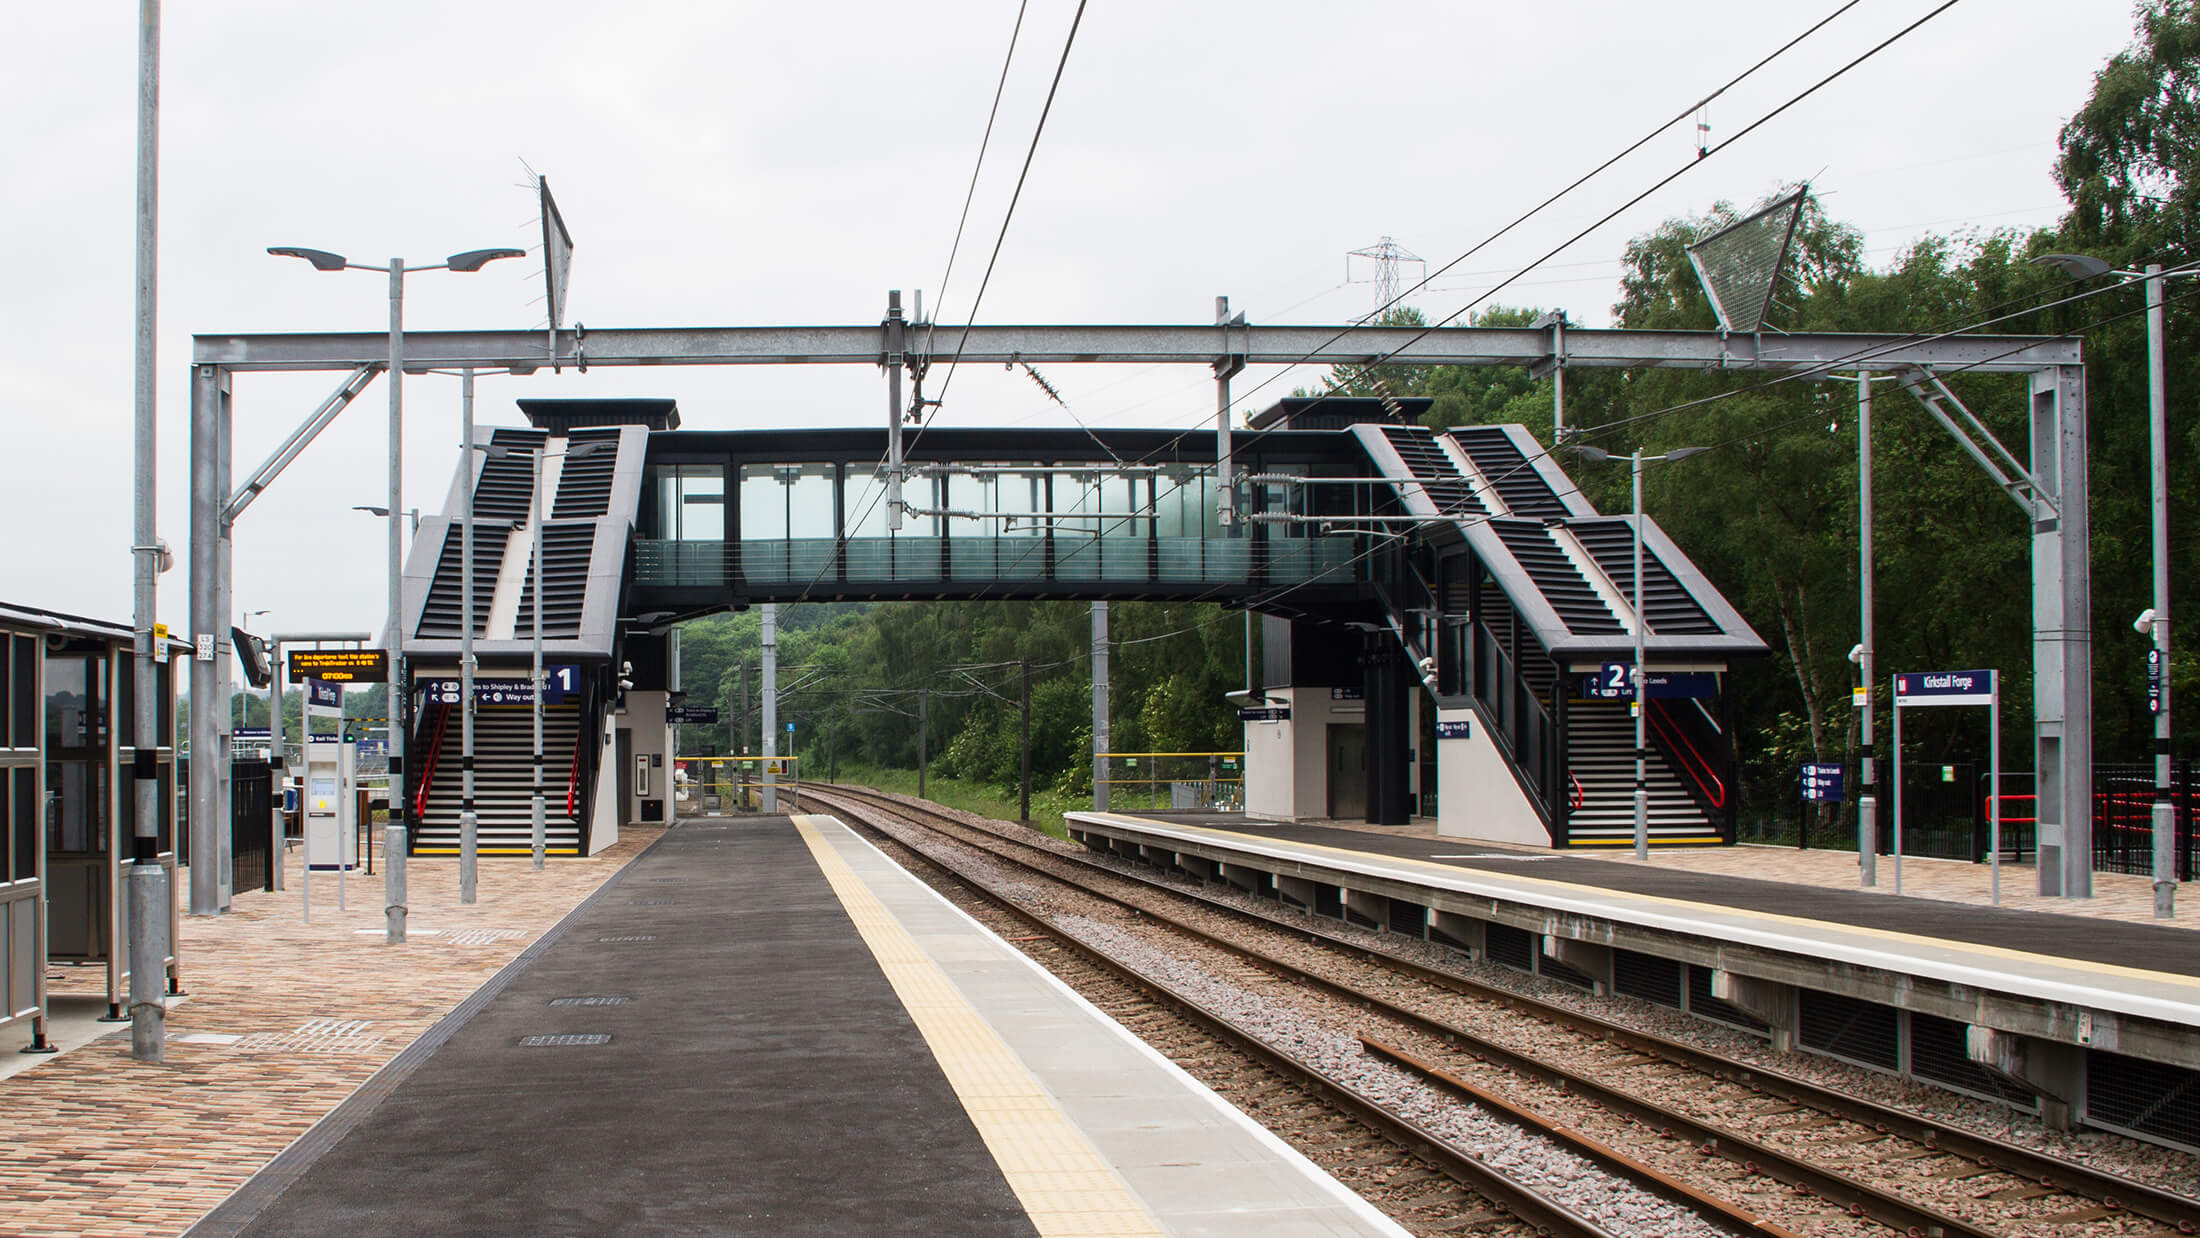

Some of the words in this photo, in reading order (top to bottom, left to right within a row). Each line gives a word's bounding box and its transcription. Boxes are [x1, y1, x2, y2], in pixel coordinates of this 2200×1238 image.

[557, 668, 571, 691] 1
[1608, 665, 1625, 687] 2
[1924, 675, 1951, 688] Kirkstall
[1952, 675, 1973, 690] Forge
[490, 683, 512, 692] Shipley
[505, 694, 521, 702] Way
